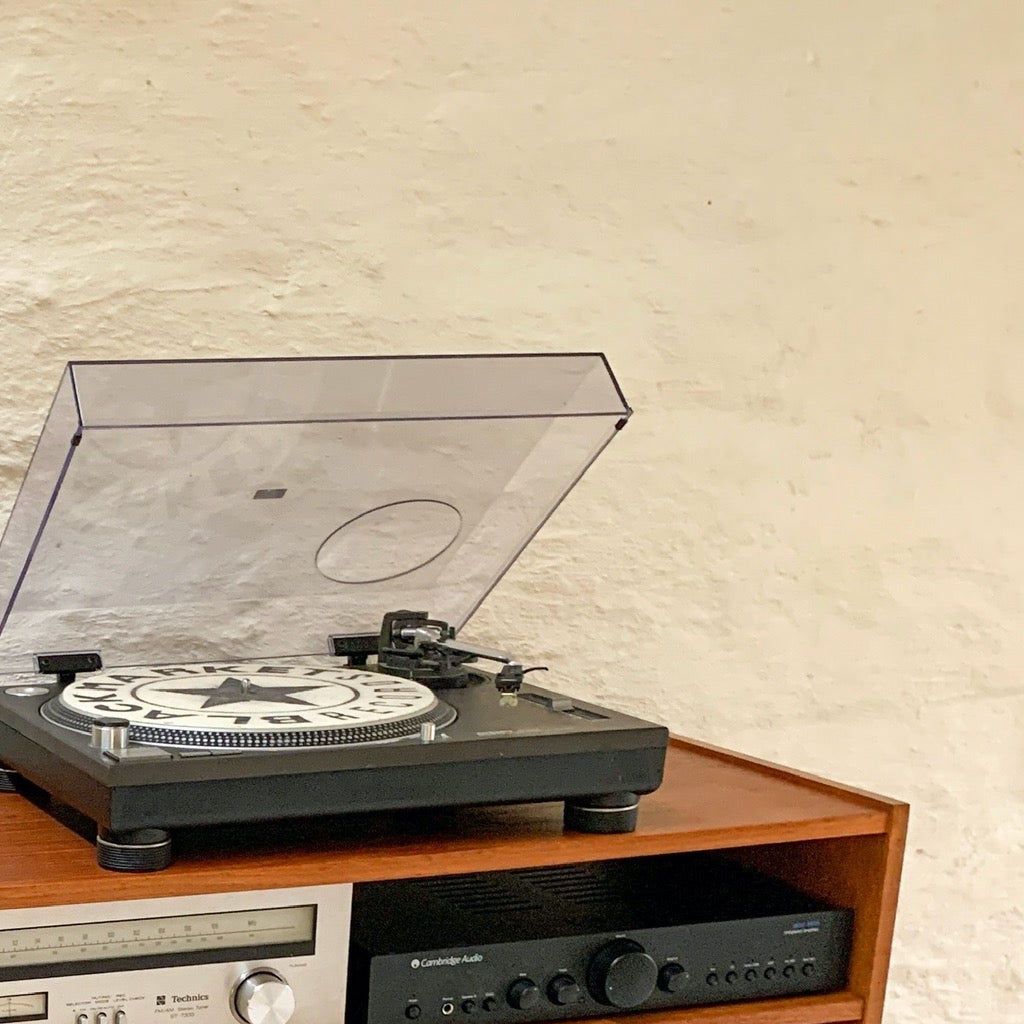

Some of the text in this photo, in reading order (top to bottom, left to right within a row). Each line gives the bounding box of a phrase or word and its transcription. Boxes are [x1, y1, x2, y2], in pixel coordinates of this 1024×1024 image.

[420, 953, 483, 968] Cambridge Audio
[171, 993, 209, 1004] Technics
